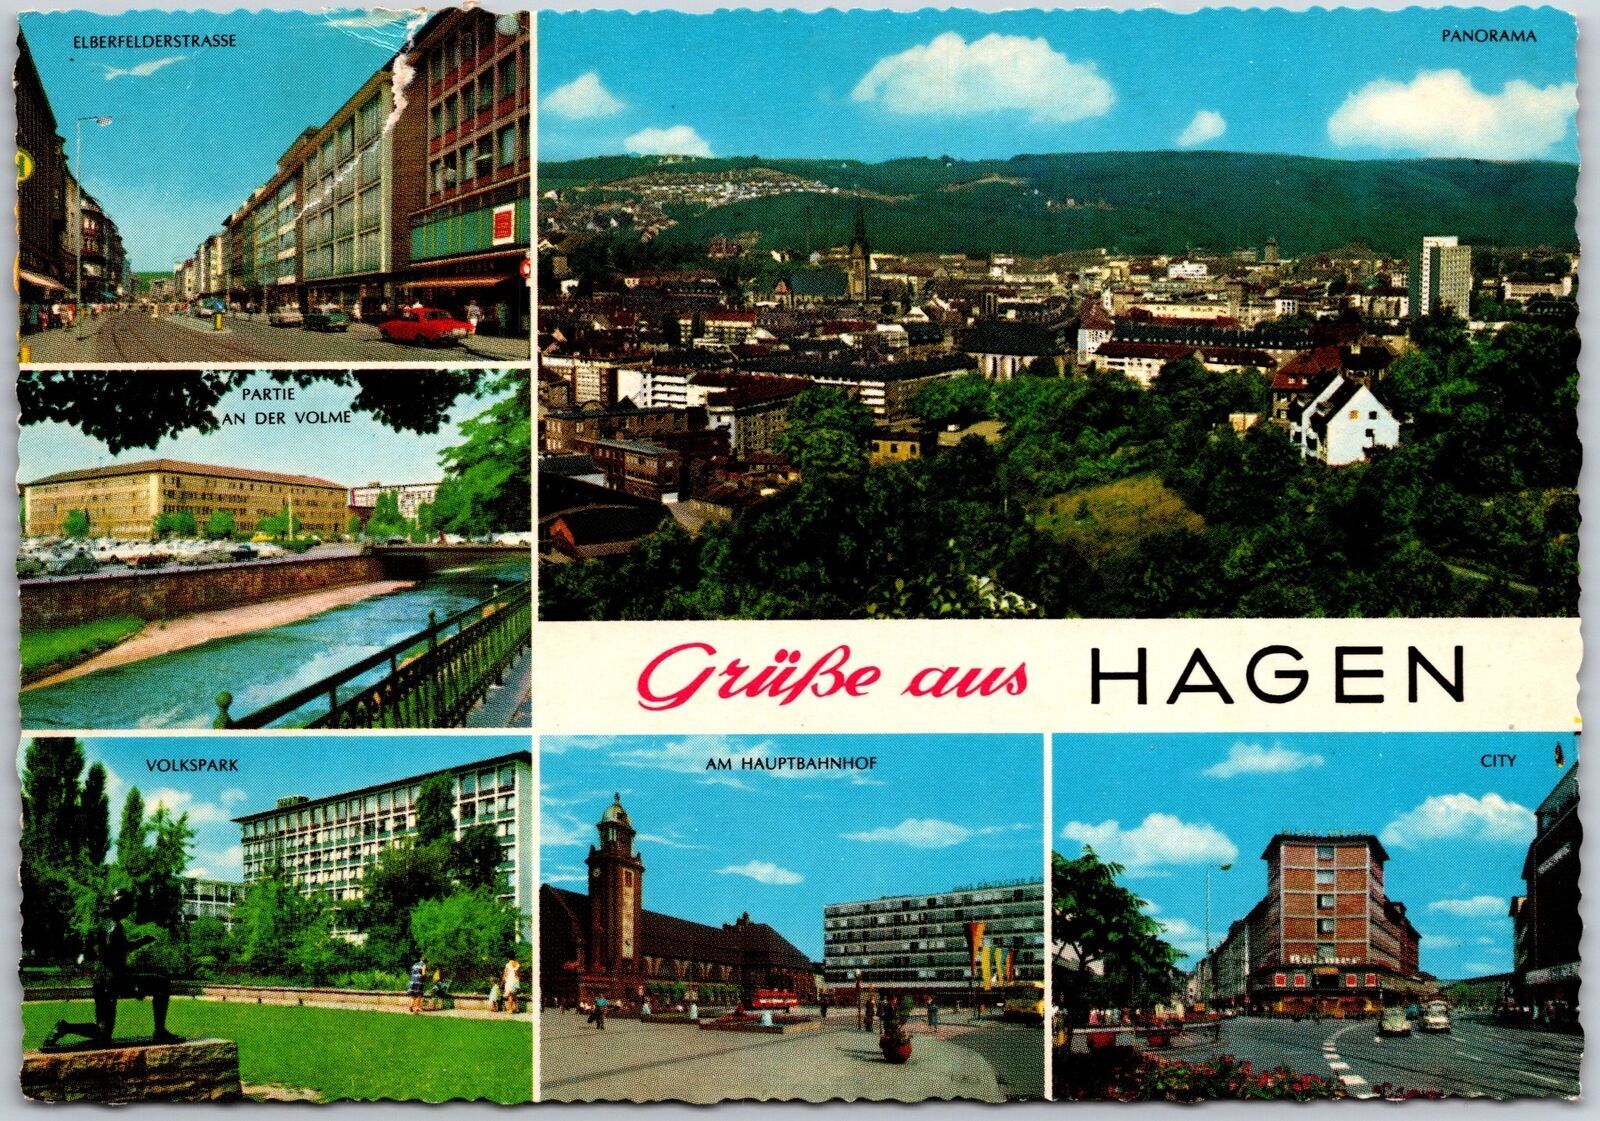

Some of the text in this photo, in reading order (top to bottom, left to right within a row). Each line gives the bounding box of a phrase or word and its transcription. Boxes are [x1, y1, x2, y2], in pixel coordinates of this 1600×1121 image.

[73, 34, 237, 49] ELBERFELDERSTRASSE
[1442, 29, 1537, 43] PANORAMA
[242, 387, 295, 401] PARTIE
[222, 410, 351, 426] AN DER VOLME
[637, 642, 1465, 711] Grüße aus HAGEN
[145, 758, 239, 773] VOLKSPARK
[705, 756, 878, 771] AM HAUPTBAHNHOF
[1480, 754, 1517, 768] CITY
